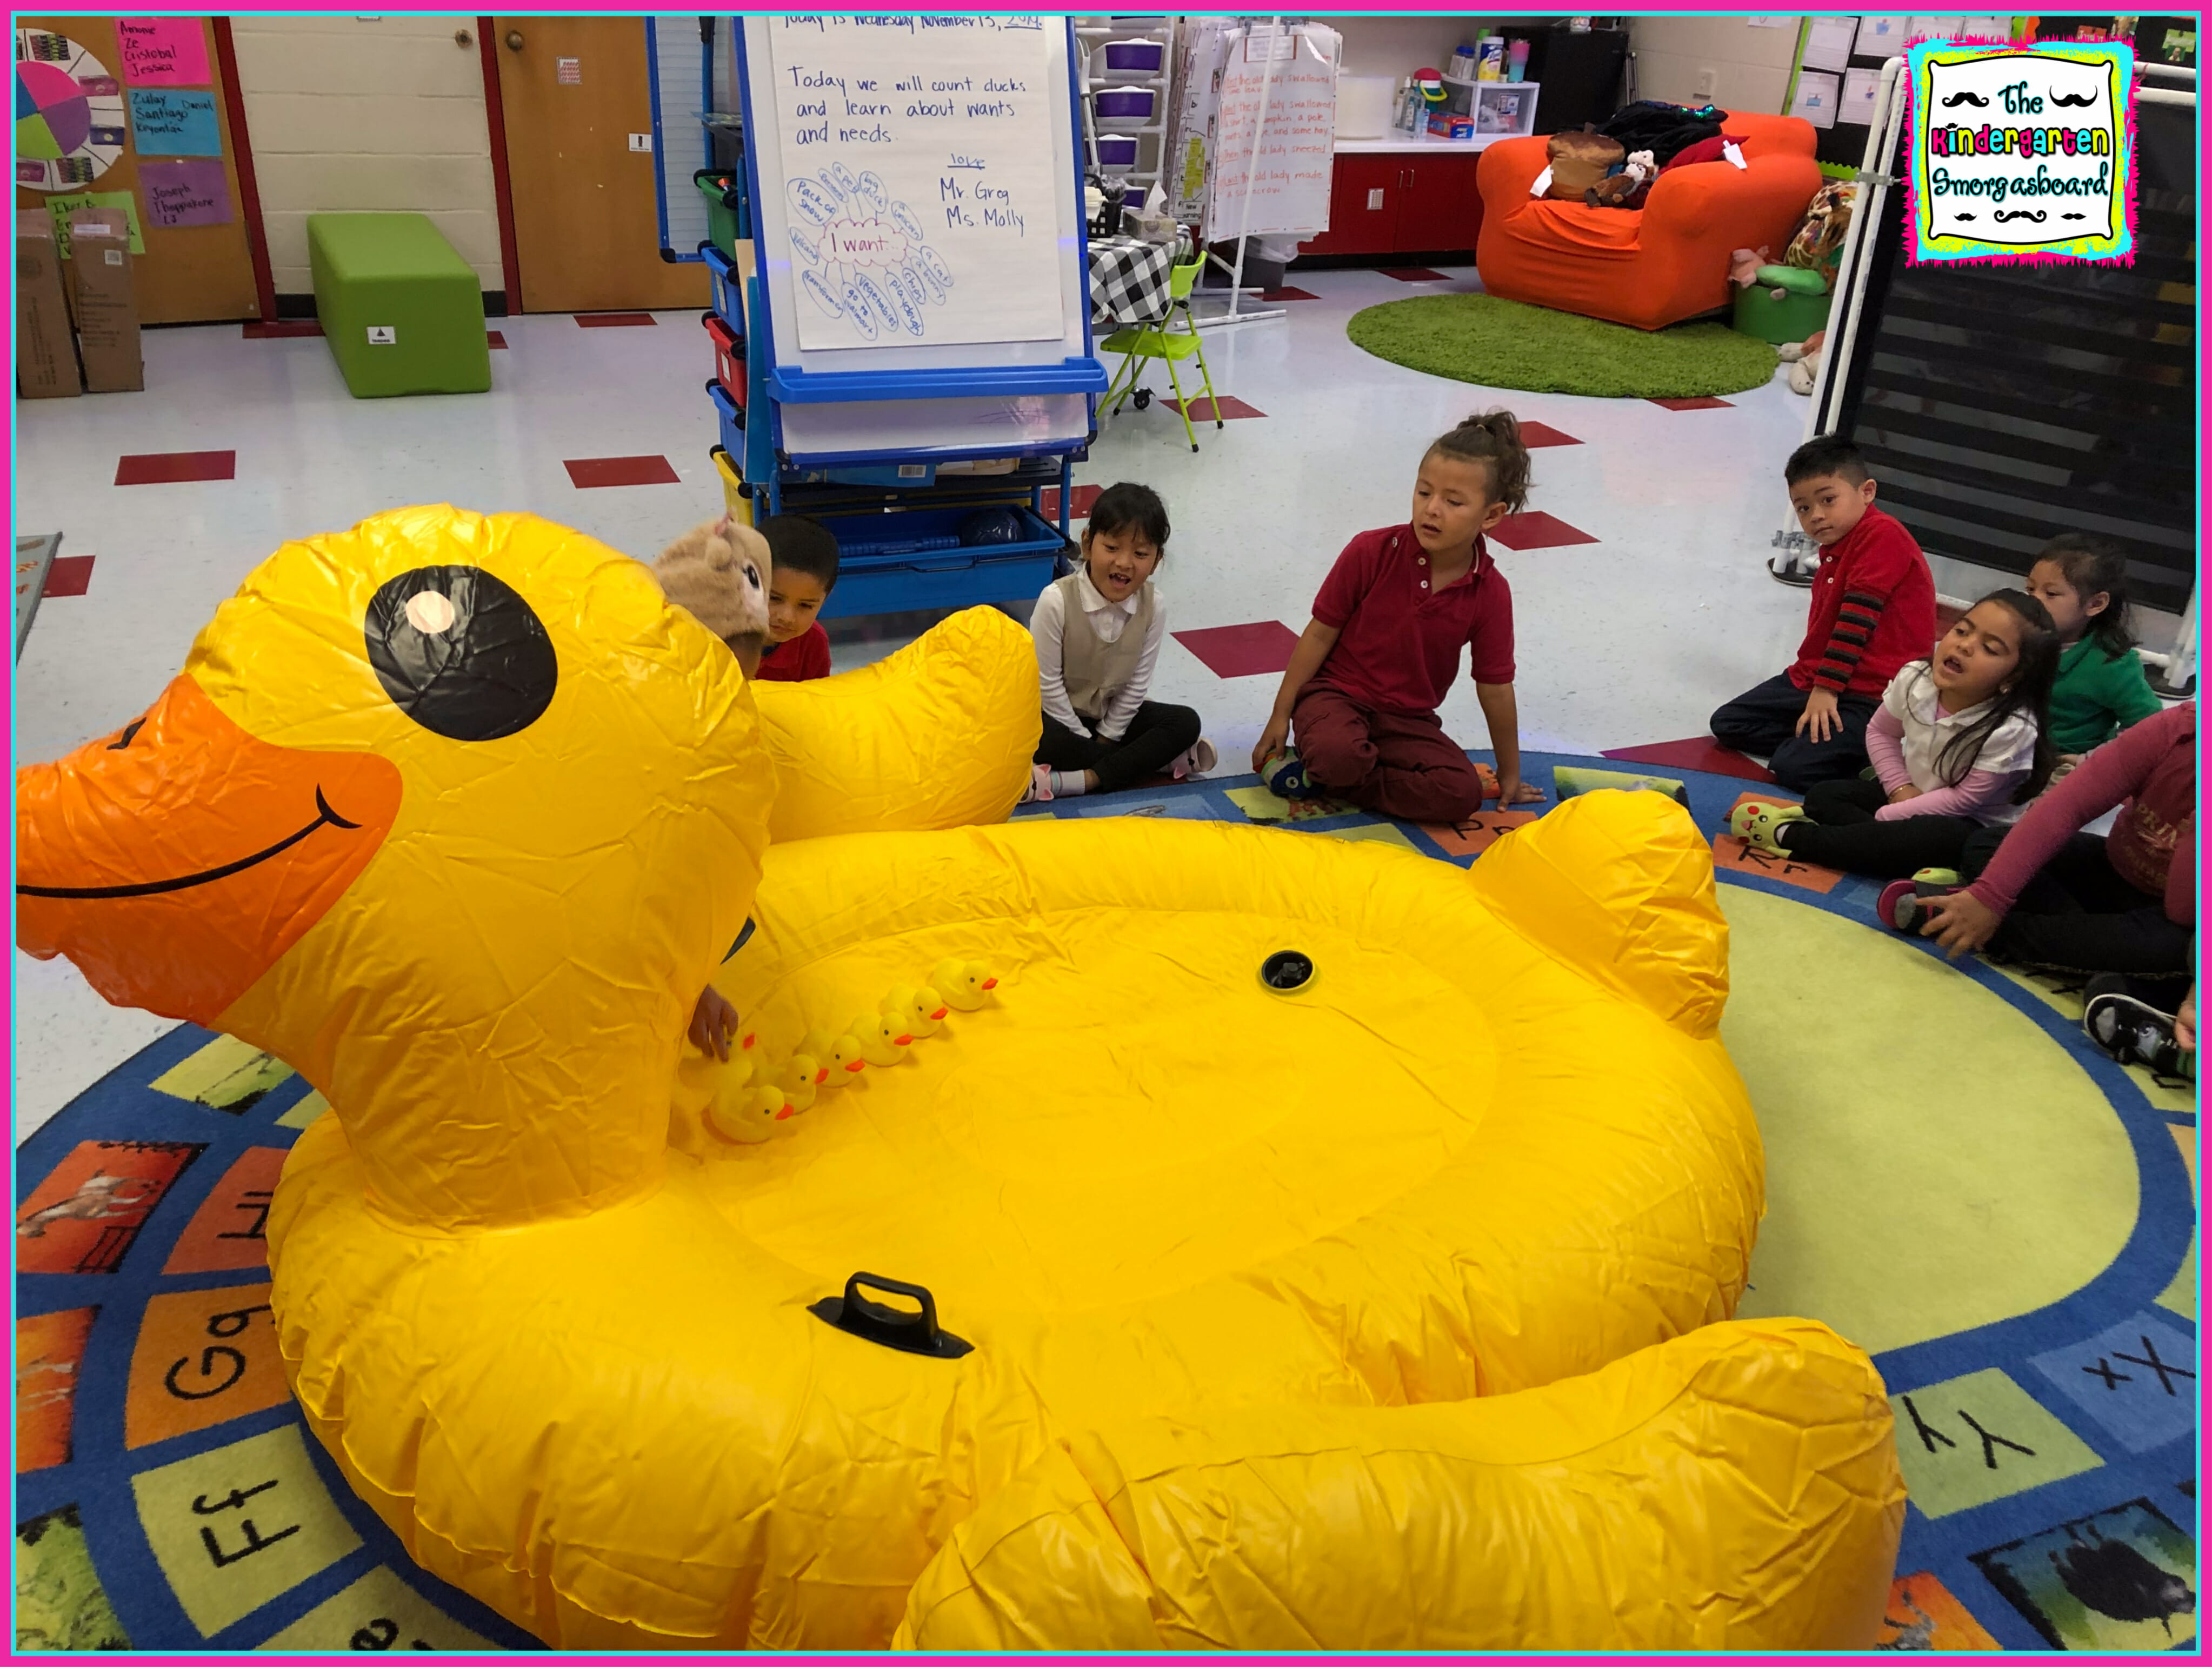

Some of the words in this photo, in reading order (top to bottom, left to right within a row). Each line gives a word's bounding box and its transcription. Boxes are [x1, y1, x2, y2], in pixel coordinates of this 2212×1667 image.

[124, 45, 177, 62] Cristobal
[132, 63, 176, 77] Jessica
[787, 65, 846, 97] Today
[856, 77, 878, 92] we
[895, 75, 923, 92] will
[931, 76, 973, 92] count
[984, 77, 1027, 92] ducks
[1270, 75, 1284, 87] ady
[1288, 74, 1329, 84] swallowed
[132, 92, 166, 107] Zulay
[797, 100, 827, 117] and
[845, 99, 892, 116] learn
[907, 99, 955, 117] about
[967, 102, 1015, 117] wants
[1270, 99, 1284, 112] lady
[1290, 99, 1331, 109] swallowed
[136, 106, 189, 122] Santiago
[796, 122, 828, 145] and
[1242, 147, 1252, 157] th
[1270, 144, 1286, 156] lady
[1292, 144, 1325, 154] sneezed
[950, 153, 985, 169] love
[1271, 169, 1290, 184] lady
[1295, 170, 1323, 179] made
[152, 183, 191, 200] Joseph
[975, 181, 1010, 205] Greg
[894, 209, 920, 240] unicorn
[985, 208, 1025, 238] Molly
[831, 232, 837, 253] I
[934, 263, 950, 282] cat
[923, 269, 944, 299] bunny
[847, 289, 858, 302] go
[889, 279, 922, 335] playdough
[1738, 845, 1808, 874] Rr
[2081, 1335, 2196, 1397] Xx
[1901, 1395, 2037, 1470] Yy
[191, 1479, 301, 1569] Ff
